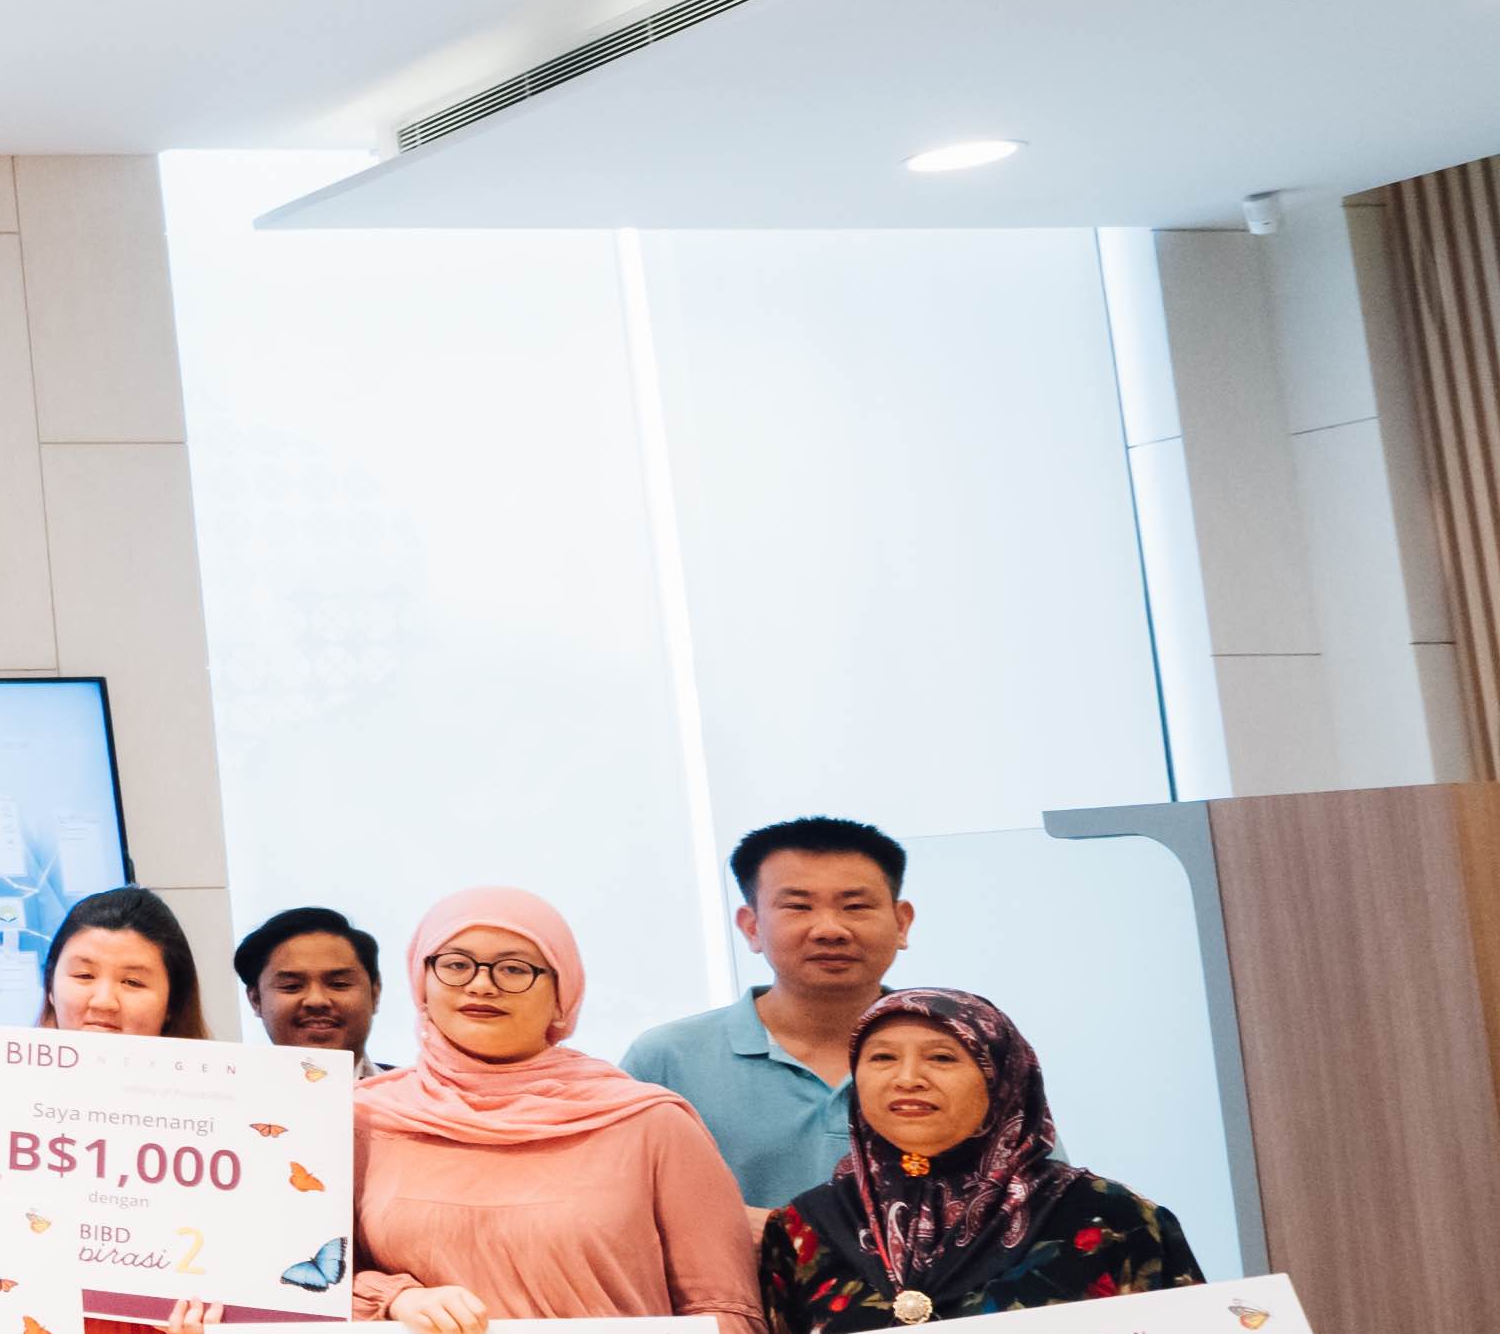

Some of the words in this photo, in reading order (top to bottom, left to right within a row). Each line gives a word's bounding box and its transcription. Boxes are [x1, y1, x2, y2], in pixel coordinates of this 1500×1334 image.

[6, 1042, 80, 1069] BIBD
[32, 1102, 80, 1124] Saya
[87, 1111, 215, 1137] memenangi
[8, 1131, 242, 1192] B$1,000
[88, 1190, 150, 1210] dengan
[79, 1223, 131, 1244] BIBD
[174, 1227, 208, 1276] 2
